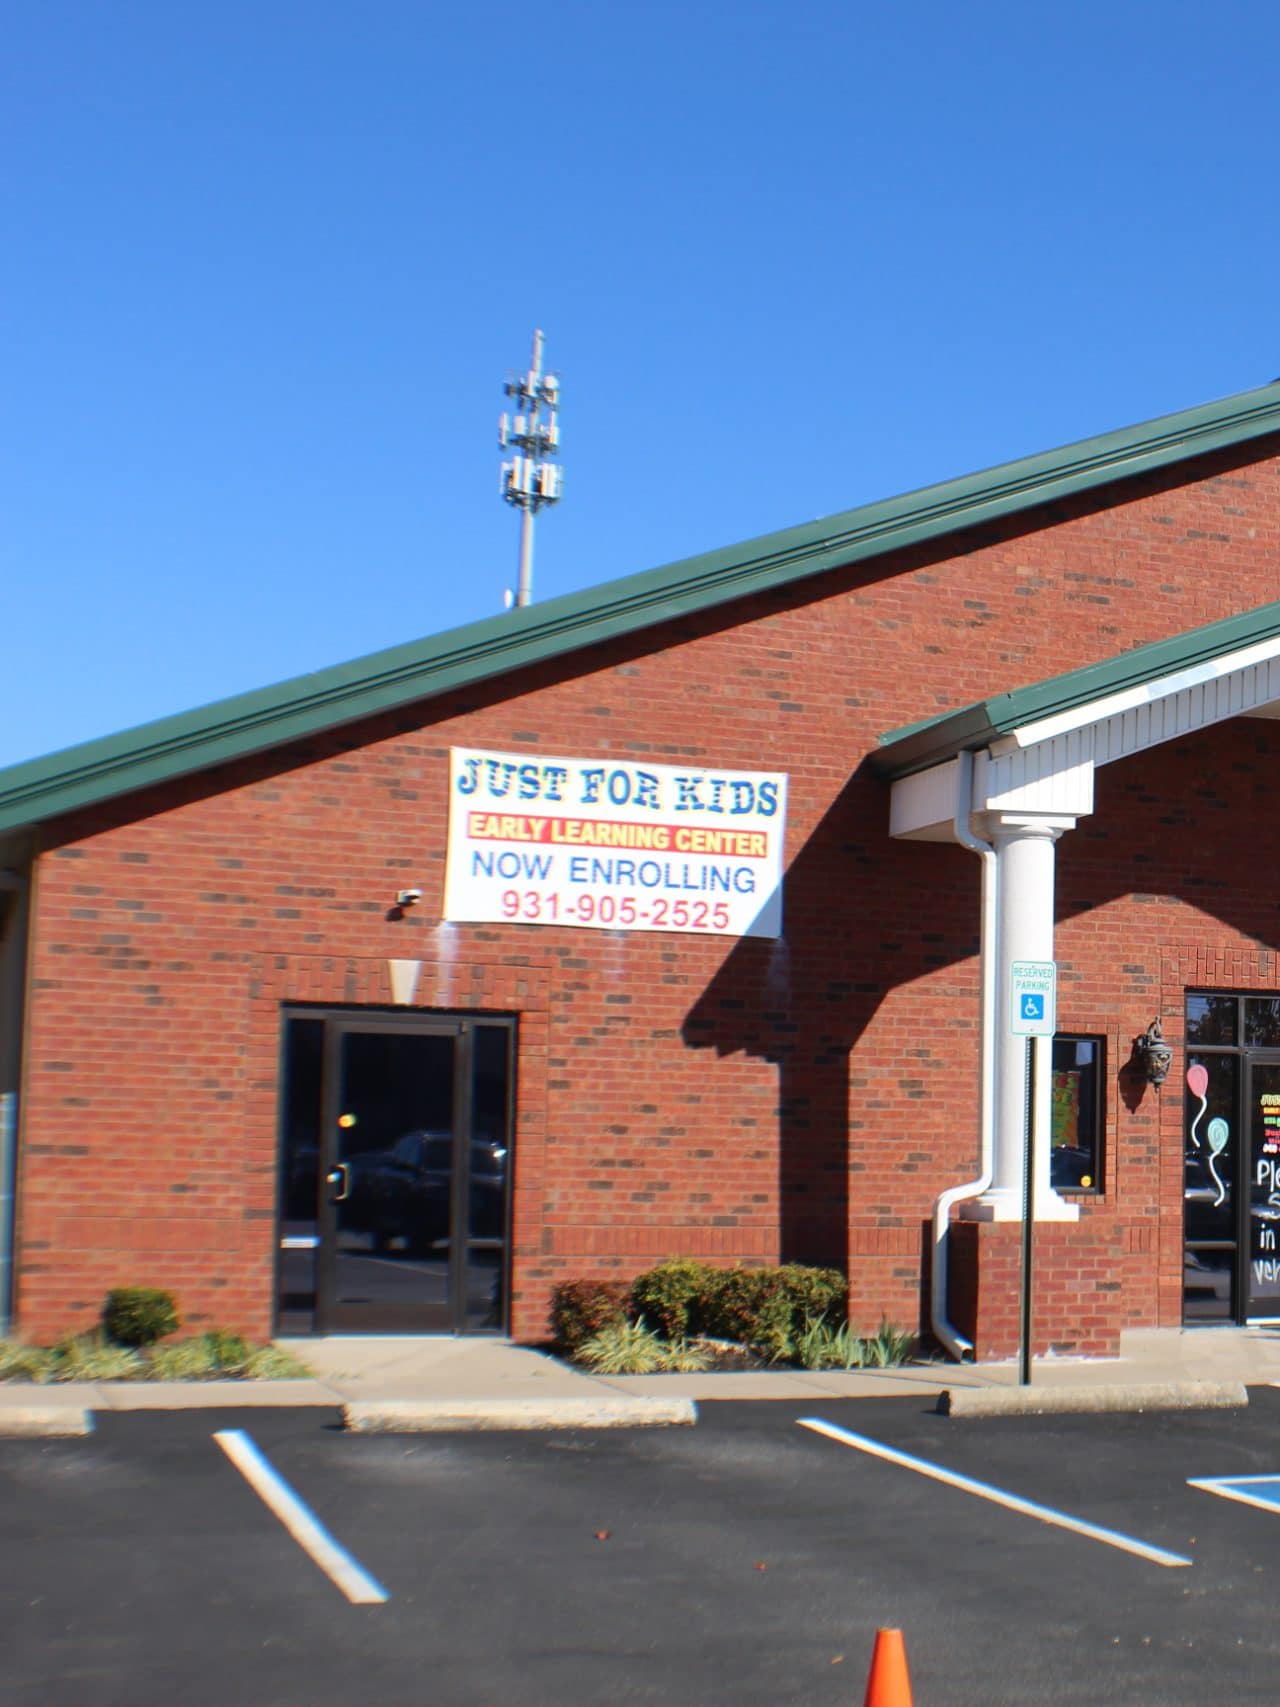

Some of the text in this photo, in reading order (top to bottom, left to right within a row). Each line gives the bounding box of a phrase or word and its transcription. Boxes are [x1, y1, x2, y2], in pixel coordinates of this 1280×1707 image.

[458, 759, 778, 817] JUST FOR KIDS
[469, 814, 766, 856] EARLY LEARNING CENTER
[472, 850, 755, 894] NOW ENROLLING
[502, 889, 730, 929] 931-905-2525
[1013, 967, 1053, 978] RESERVED
[1015, 980, 1050, 991] PARKING
[1260, 1223, 1276, 1250] in
